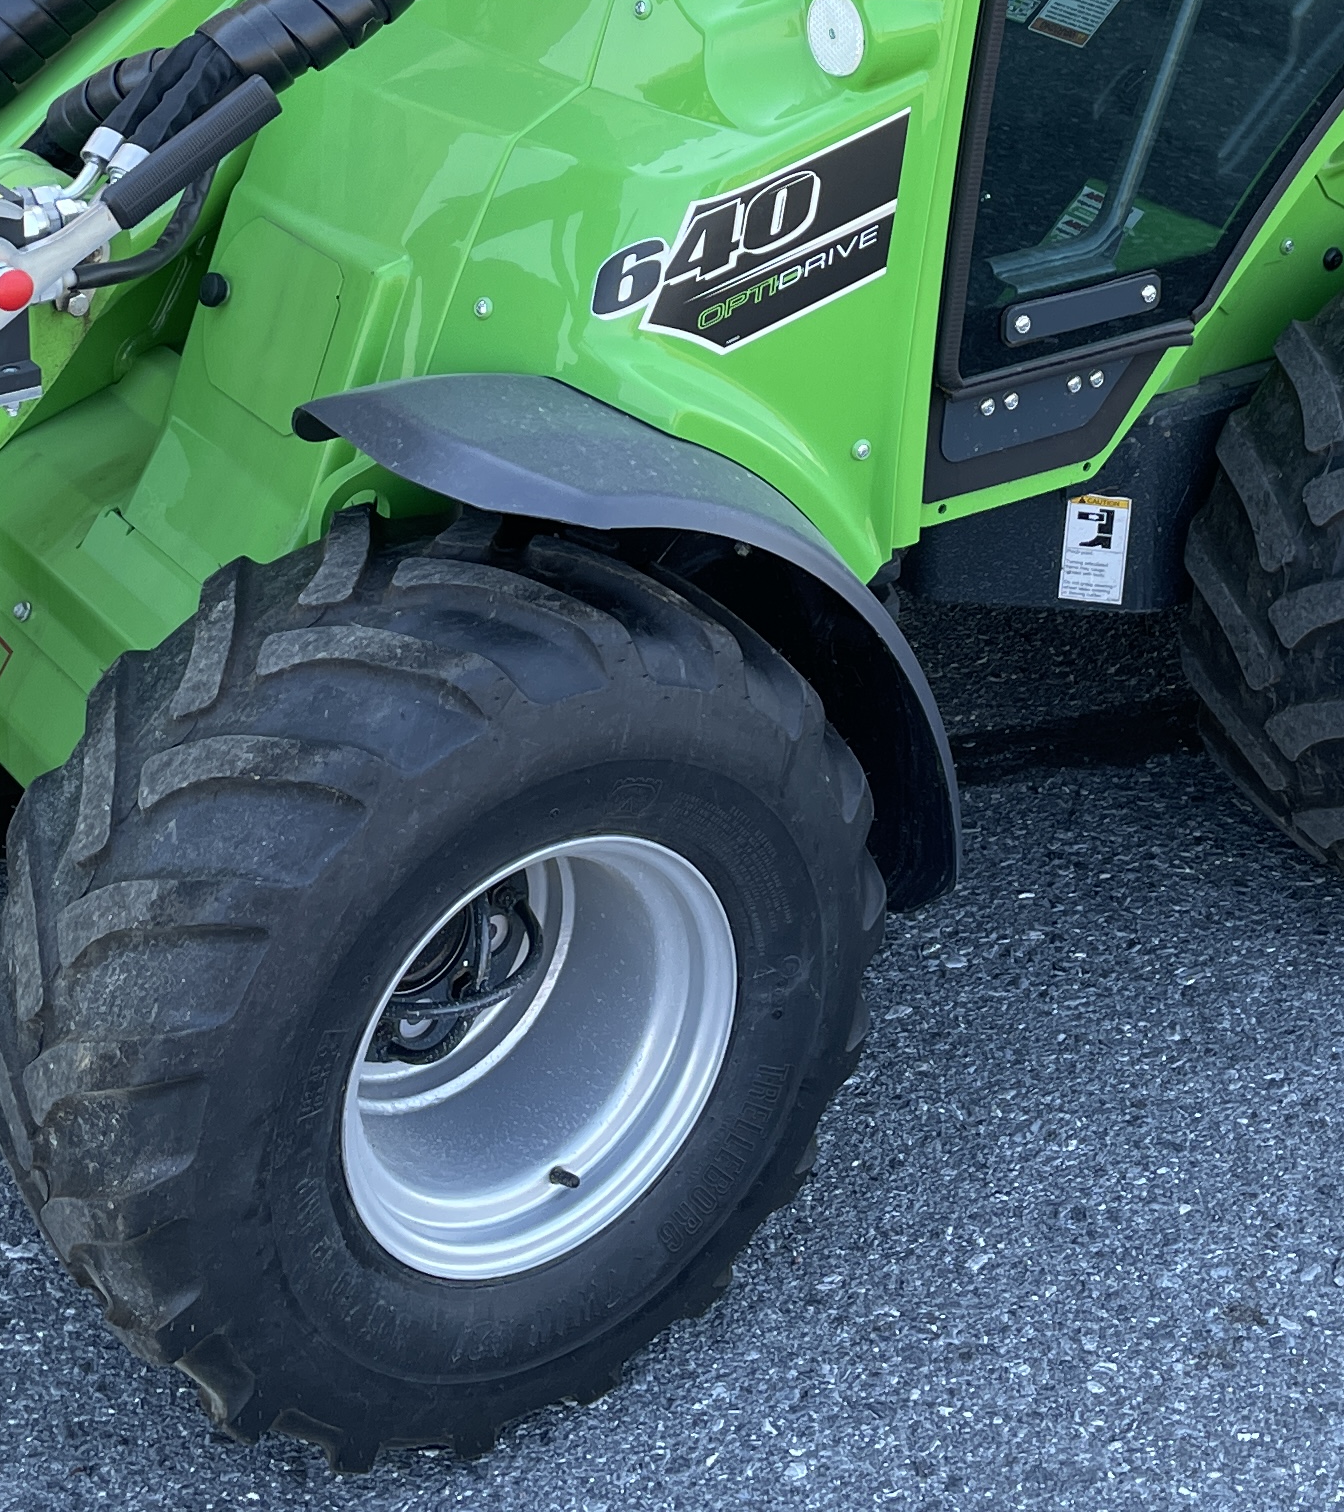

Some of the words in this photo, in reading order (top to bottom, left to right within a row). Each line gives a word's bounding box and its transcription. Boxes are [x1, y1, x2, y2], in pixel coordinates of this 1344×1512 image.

[592, 171, 821, 320] 640
[697, 225, 879, 329] OPTIDRIVE
[1086, 498, 1120, 507] CAUTION
[659, 1063, 795, 1253] TRELLEBORG
